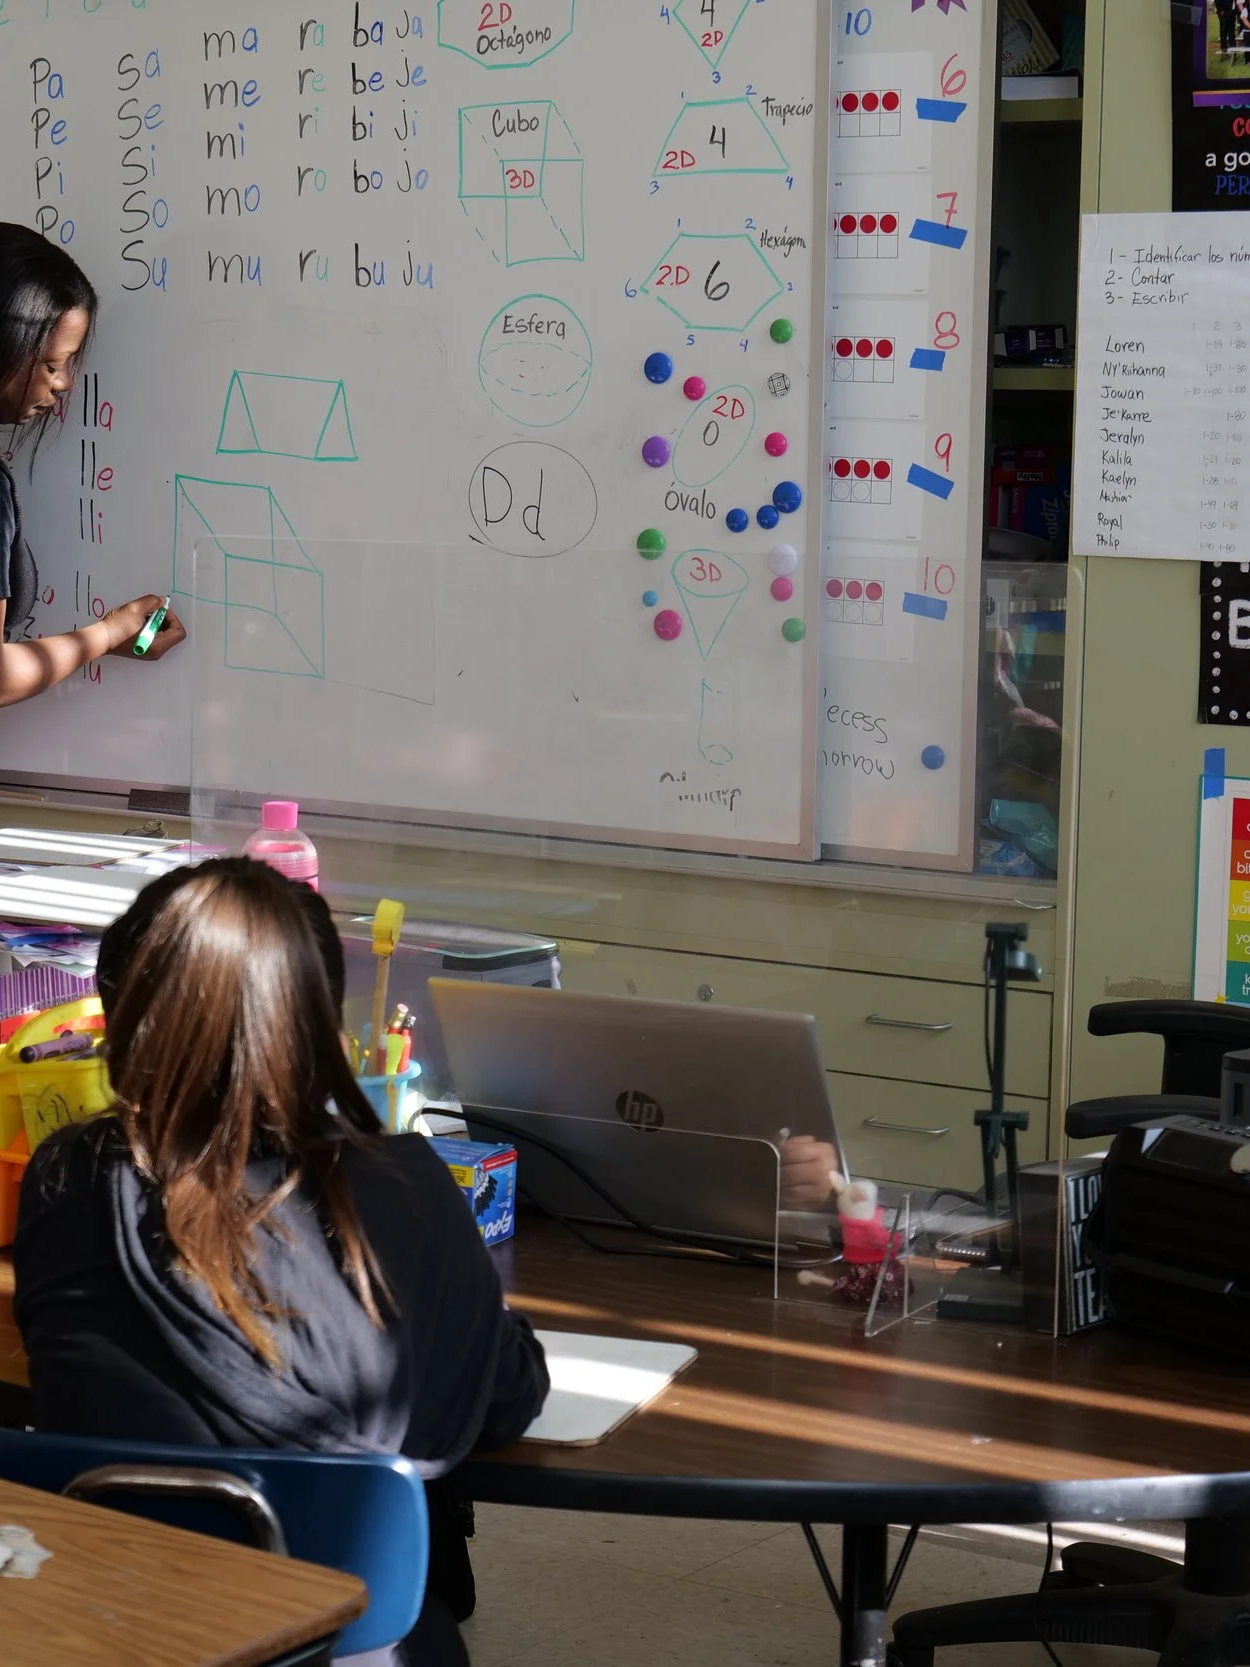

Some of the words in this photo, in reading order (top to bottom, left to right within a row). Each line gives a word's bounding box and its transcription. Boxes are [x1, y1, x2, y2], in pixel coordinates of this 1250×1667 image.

[478, 3, 512, 31] 2D
[845, 9, 871, 36] 10
[204, 28, 258, 61] ma
[300, 19, 323, 51] ra
[353, 1, 383, 47] ba
[476, 26, 552, 55] Octágono
[701, 31, 723, 47] 2D
[204, 80, 261, 109] me
[298, 68, 326, 94] re
[351, 62, 384, 95] be
[396, 49, 427, 87] je
[941, 53, 966, 98] 6
[492, 109, 539, 137] Cubo
[761, 96, 813, 126] Trapecio
[207, 123, 244, 159] mi
[352, 106, 373, 141] bi
[394, 99, 417, 141] ji
[709, 125, 725, 158] 4
[662, 150, 695, 169] 2D
[1205, 153, 1216, 167] a
[206, 185, 260, 216] mo
[298, 165, 325, 196] ro
[353, 159, 382, 193] bo
[397, 148, 428, 192] jo
[506, 169, 534, 189] 3D
[936, 192, 958, 229] 7
[208, 251, 261, 286] mu
[355, 243, 384, 287] bu
[403, 240, 433, 289] ju
[1134, 245, 1201, 264] Identificar
[1209, 244, 1223, 264] los
[1132, 266, 1174, 286] Contar
[1132, 289, 1189, 306] Escribir
[502, 313, 565, 340] Esfera
[934, 312, 960, 349] 8
[1106, 335, 1144, 353] Loren
[1101, 386, 1143, 400] Jowan
[712, 396, 744, 420] 2D
[1100, 427, 1144, 447] Jeralyn
[935, 433, 952, 472] 9
[1102, 449, 1132, 466] Kalila
[1102, 469, 1136, 489] Kaelyn
[1097, 512, 1122, 531] Royal
[690, 557, 722, 582] 3D
[924, 557, 955, 594] 10
[623, 1091, 660, 1132] hp
